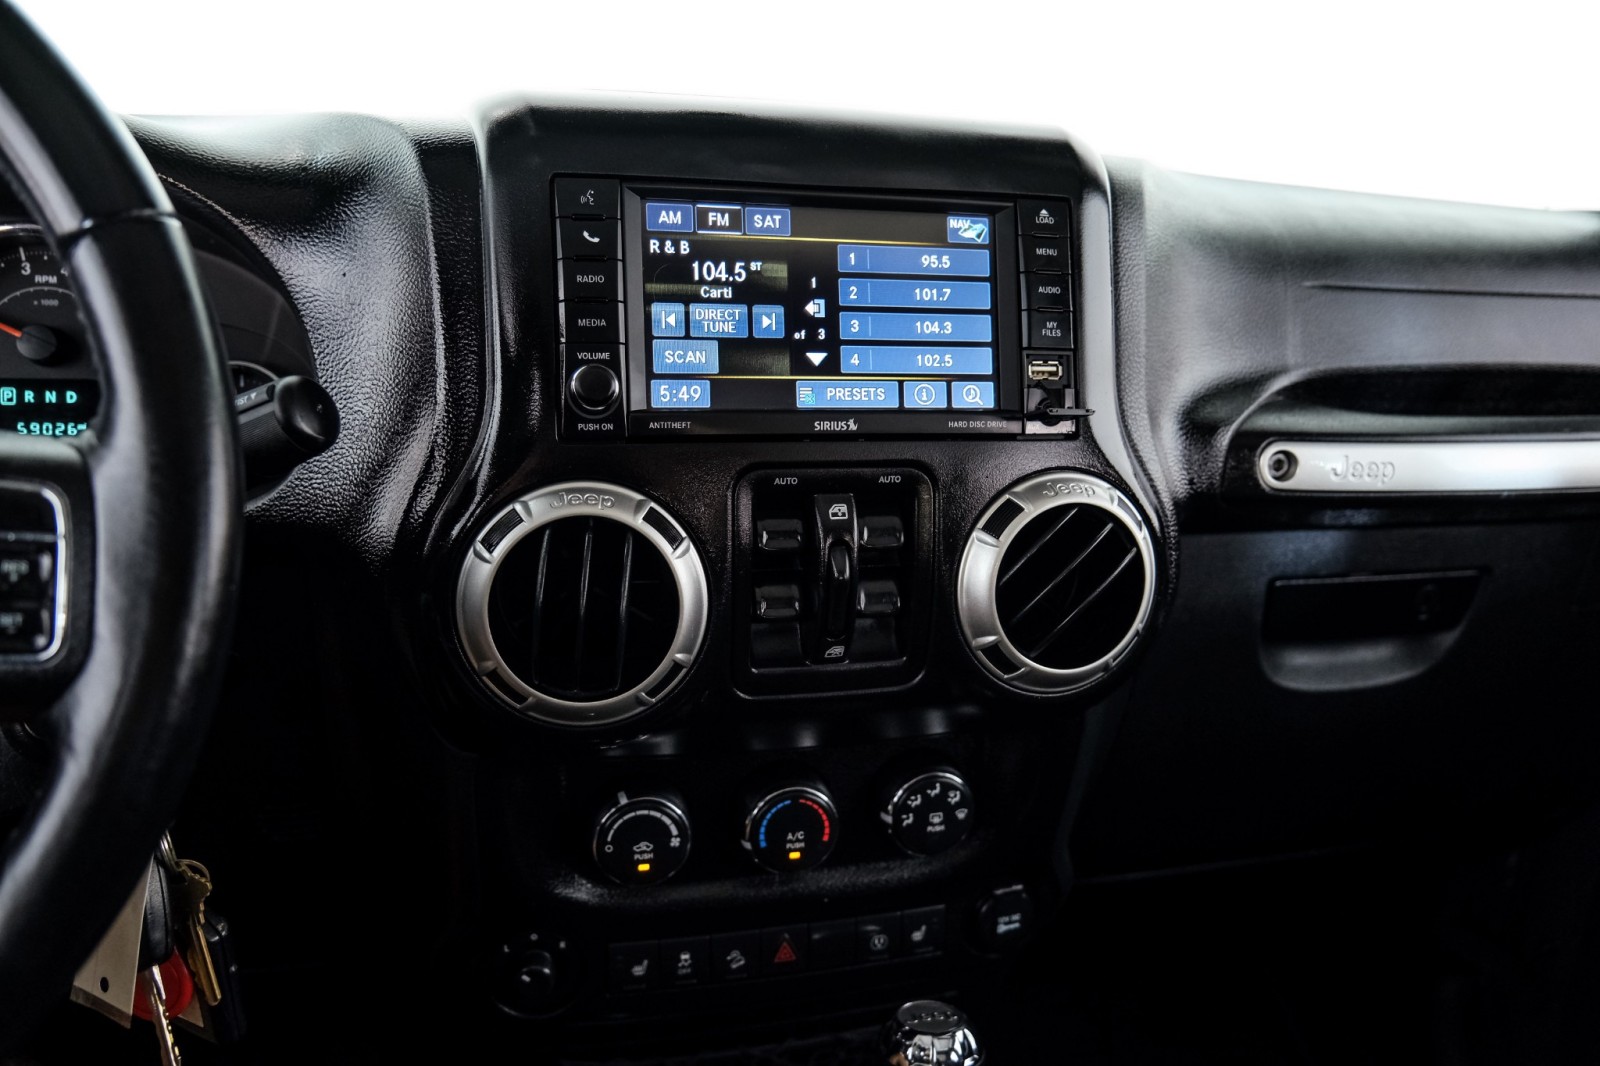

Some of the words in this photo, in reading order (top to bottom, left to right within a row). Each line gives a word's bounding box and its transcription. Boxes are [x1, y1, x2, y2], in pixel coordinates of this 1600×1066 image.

[659, 210, 682, 224] AM
[708, 212, 730, 226] FM
[754, 214, 782, 229] SAT
[949, 218, 970, 228] NAV
[1036, 216, 1054, 224] LOAD
[650, 240, 660, 254] R
[664, 240, 676, 254] &
[680, 240, 690, 255] B
[1036, 248, 1058, 256] MENU
[849, 252, 856, 266] 1
[921, 255, 950, 268] 95.5
[20, 262, 31, 276] 3
[692, 260, 747, 282] 104.5
[750, 262, 762, 271] ST
[34, 274, 58, 284] RPM
[576, 274, 604, 284] RADIO
[810, 276, 818, 288] 1
[849, 286, 858, 299] 2
[914, 288, 952, 302] 101.7
[1038, 286, 1061, 294] AUDIO
[695, 308, 742, 320] DIRECT
[578, 318, 606, 327] MEDIA
[702, 321, 736, 332] TUNE
[850, 320, 859, 332] 3
[914, 321, 952, 334] 104.3
[1046, 322, 1058, 330] MY
[794, 329, 806, 340] of
[818, 328, 826, 340] 3
[1042, 328, 1062, 337] FILES
[577, 352, 610, 360] VOLUME
[664, 350, 706, 364] SCAN
[850, 353, 860, 366] 4
[916, 354, 953, 367] 102.5
[4, 390, 13, 402] P
[24, 390, 35, 404] R
[45, 390, 56, 404] N
[66, 390, 78, 404] D
[660, 386, 702, 402] 5:49
[826, 388, 885, 400] PRESETS
[578, 423, 600, 431] PUSH
[601, 423, 614, 431] ON
[649, 422, 691, 430] ANTITHEFT
[814, 420, 848, 430] SIRIUS
[1330, 454, 1396, 485] Jeep
[774, 477, 798, 485] AUTO
[878, 475, 902, 483] AUTO
[1043, 482, 1096, 498] Jeep
[550, 492, 615, 510] Jeep
[786, 831, 804, 841] A/C
[786, 841, 804, 850] PUSH
[634, 852, 654, 860] PUSH
